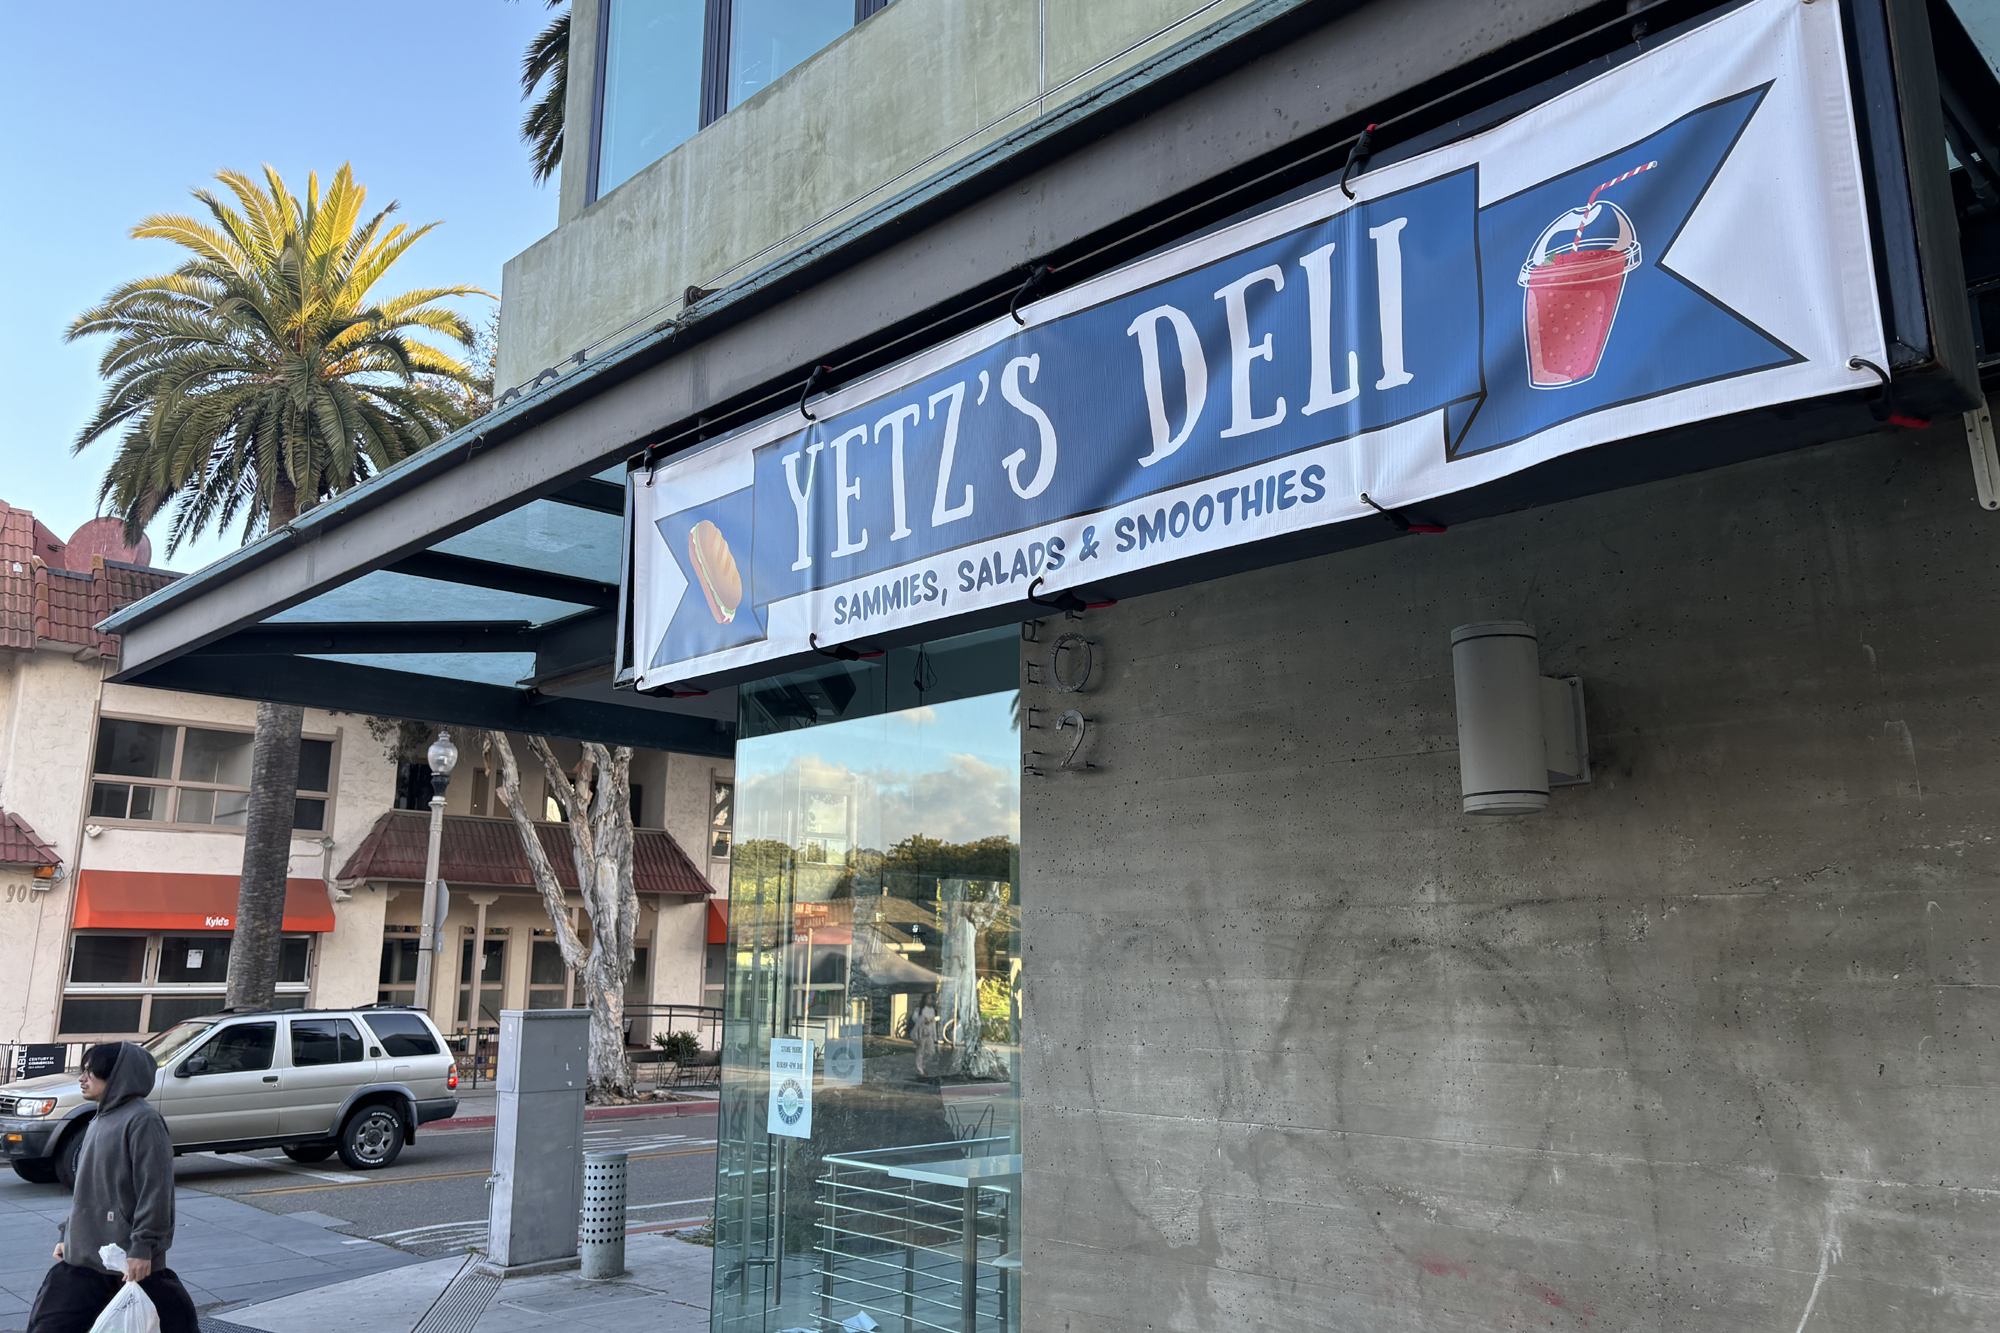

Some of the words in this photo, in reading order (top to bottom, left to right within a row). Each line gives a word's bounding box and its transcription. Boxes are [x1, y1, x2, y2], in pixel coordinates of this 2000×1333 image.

[782, 353, 1058, 572] YETZ'S
[1127, 217, 1414, 468] DELI
[833, 569, 948, 626] SAMMIES,
[957, 536, 1066, 593] SALADS
[1078, 525, 1100, 562] &
[1115, 464, 1327, 552] SMOOTHIES
[205, 916, 230, 928] Kyle's
